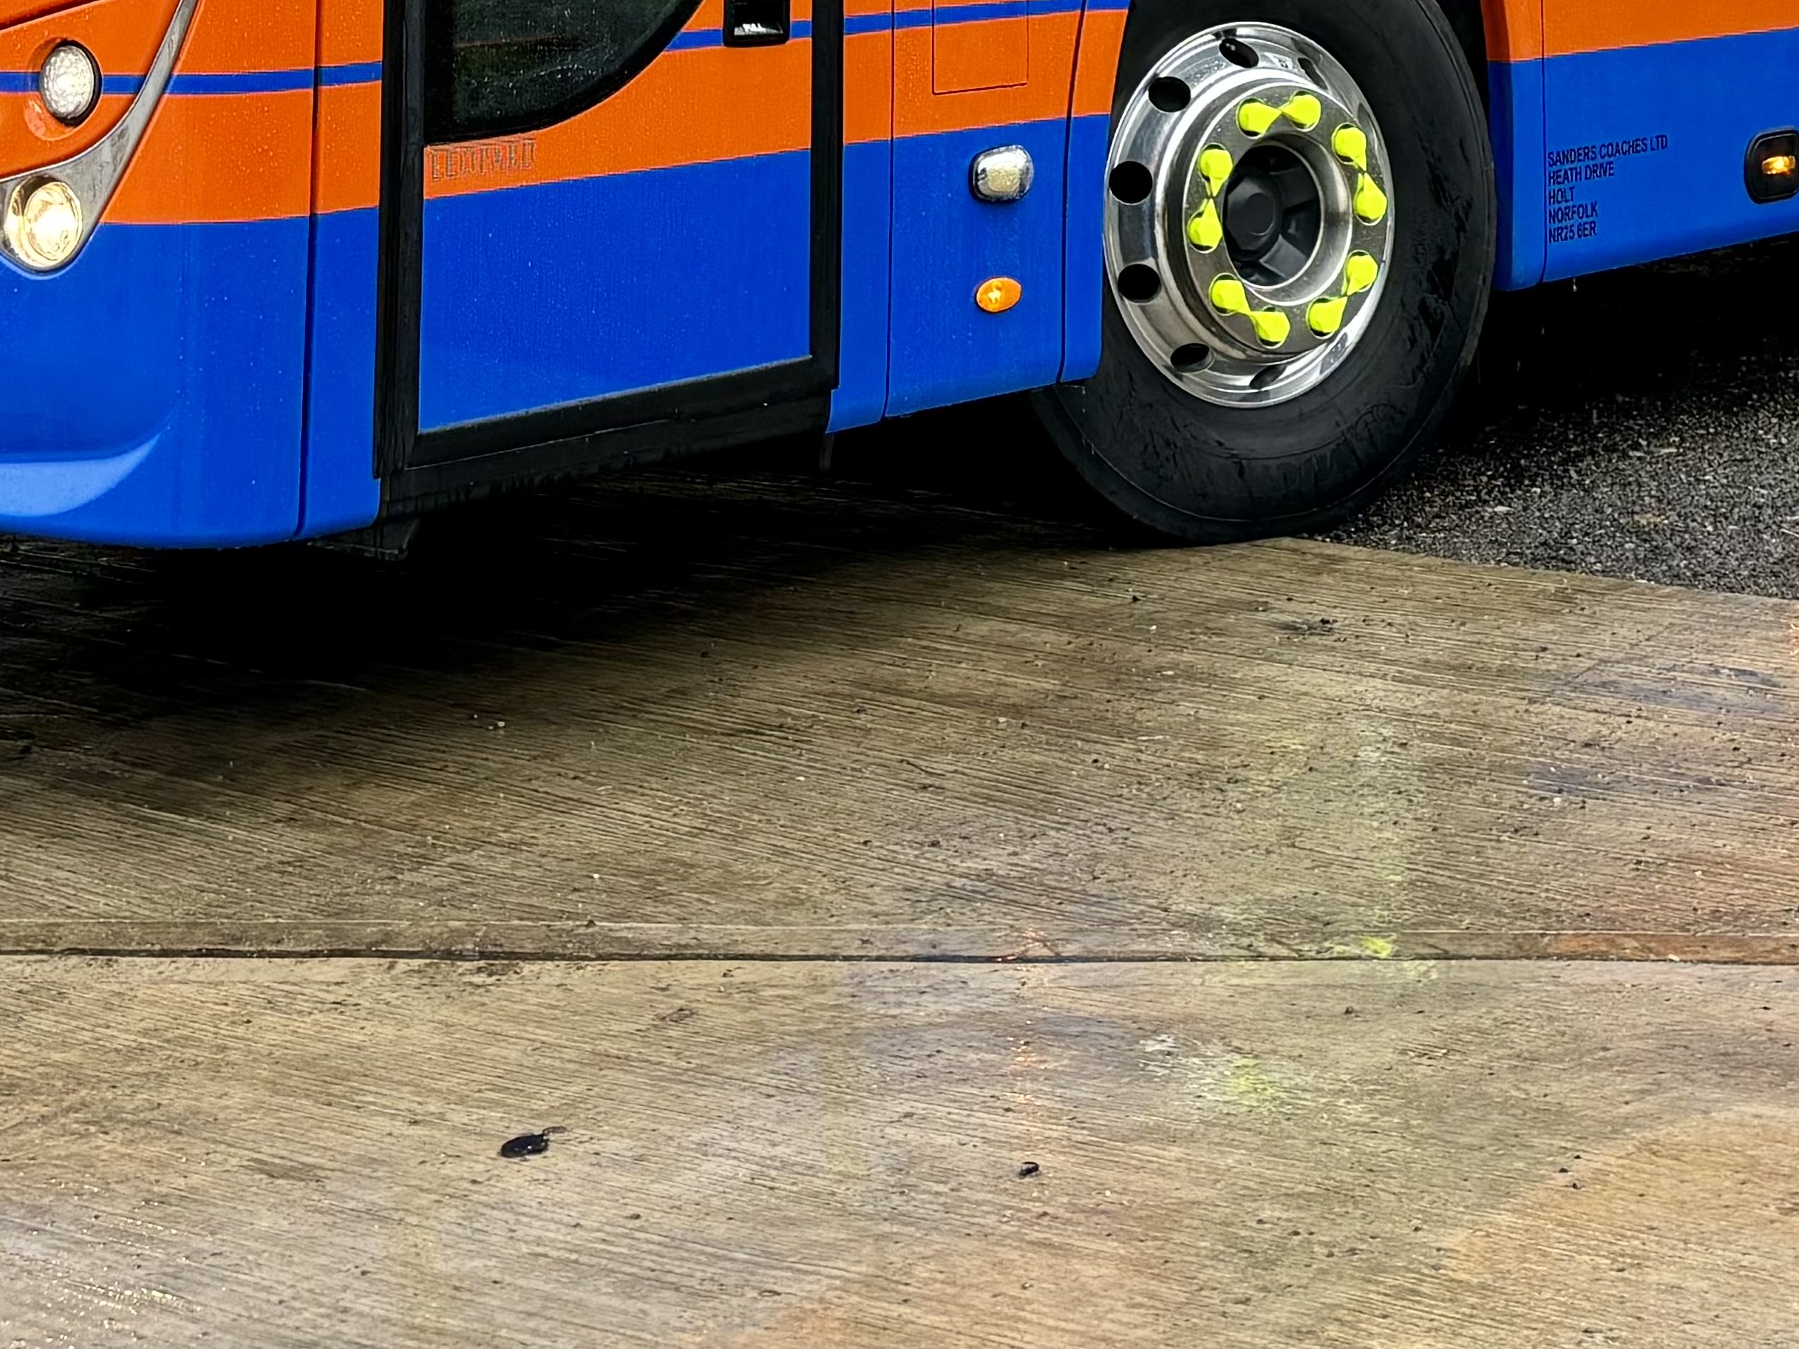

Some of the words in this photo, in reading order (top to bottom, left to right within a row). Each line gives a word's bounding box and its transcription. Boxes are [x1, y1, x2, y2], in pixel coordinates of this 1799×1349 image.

[1547, 144, 1598, 168] SANDERS
[1599, 137, 1648, 160] COACHES
[1649, 134, 1668, 152] LTD
[1548, 166, 1582, 187] HEATH
[1584, 161, 1614, 181] DRIVE
[1548, 186, 1575, 206] HOLT
[1548, 201, 1599, 224] NORFOLK
[1548, 223, 1575, 244] NR25
